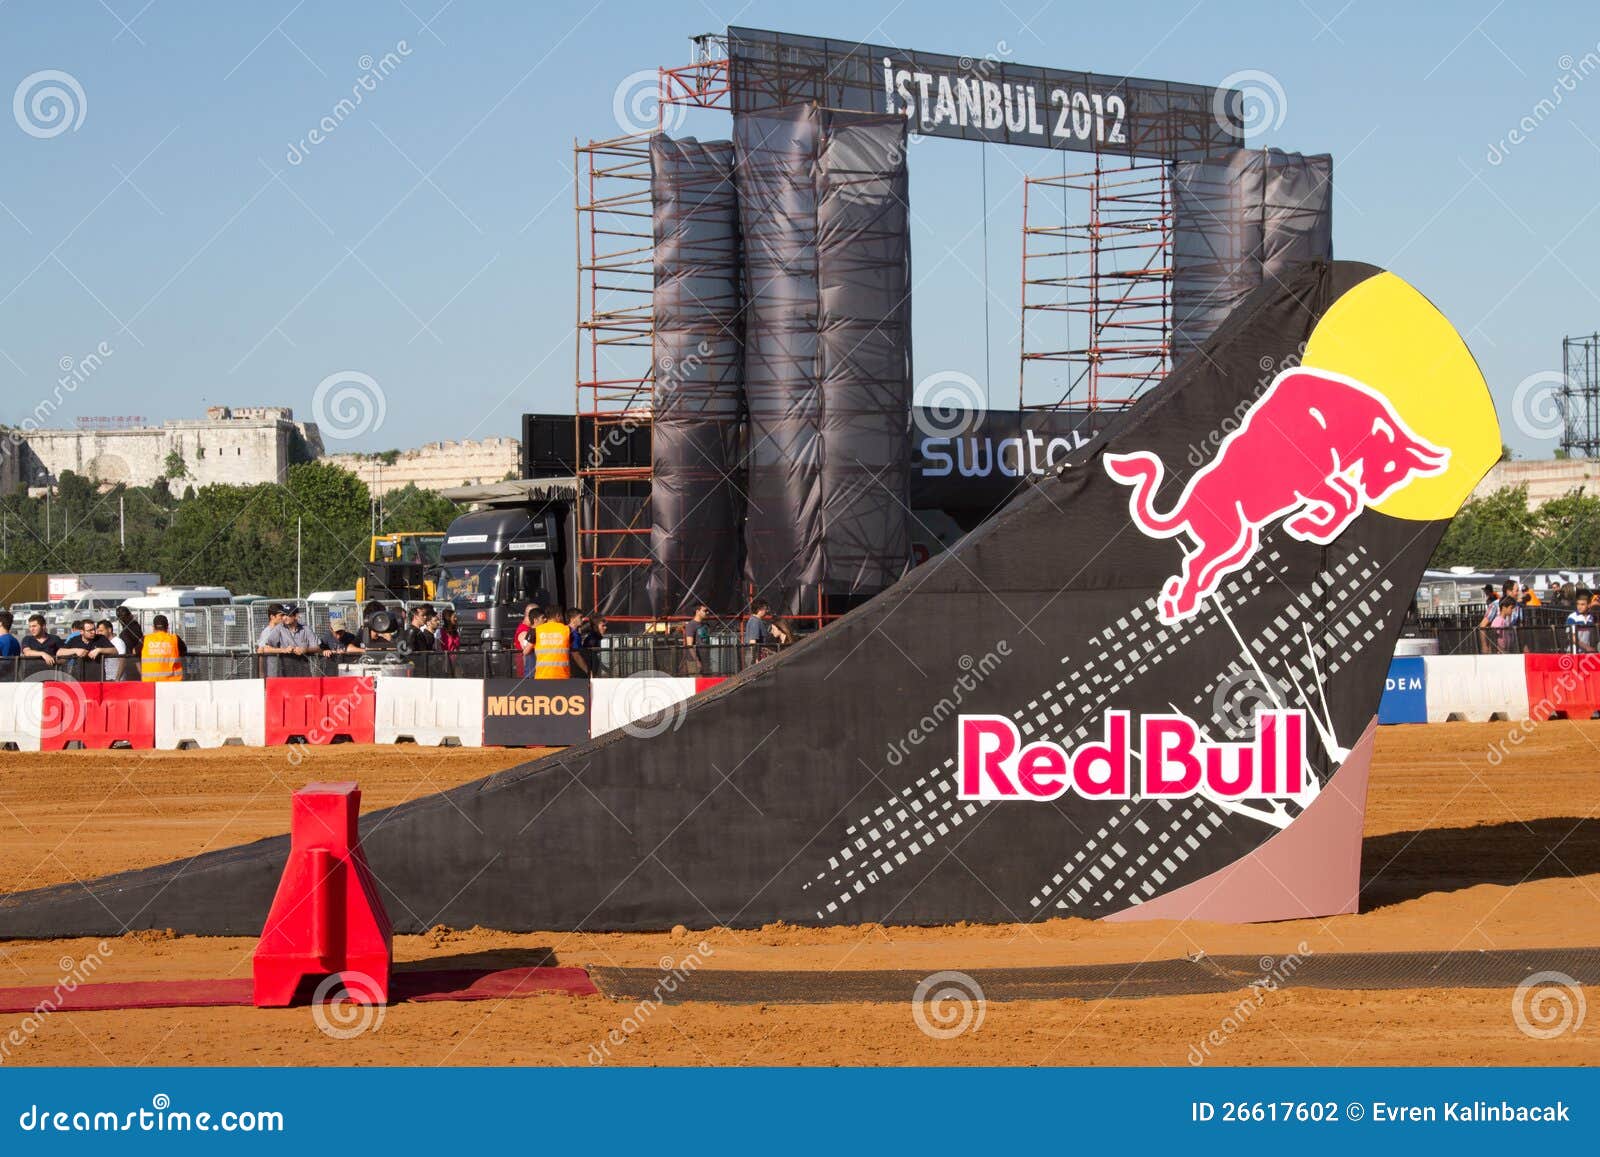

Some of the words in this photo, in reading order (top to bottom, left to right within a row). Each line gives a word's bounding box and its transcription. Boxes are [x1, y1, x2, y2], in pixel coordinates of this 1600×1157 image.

[883, 57, 1043, 135] İSTANBUL
[1050, 89, 1127, 144] 2012
[1385, 678, 1422, 692] DEM
[959, 710, 1130, 800] Red
[1141, 709, 1306, 800] Bull
